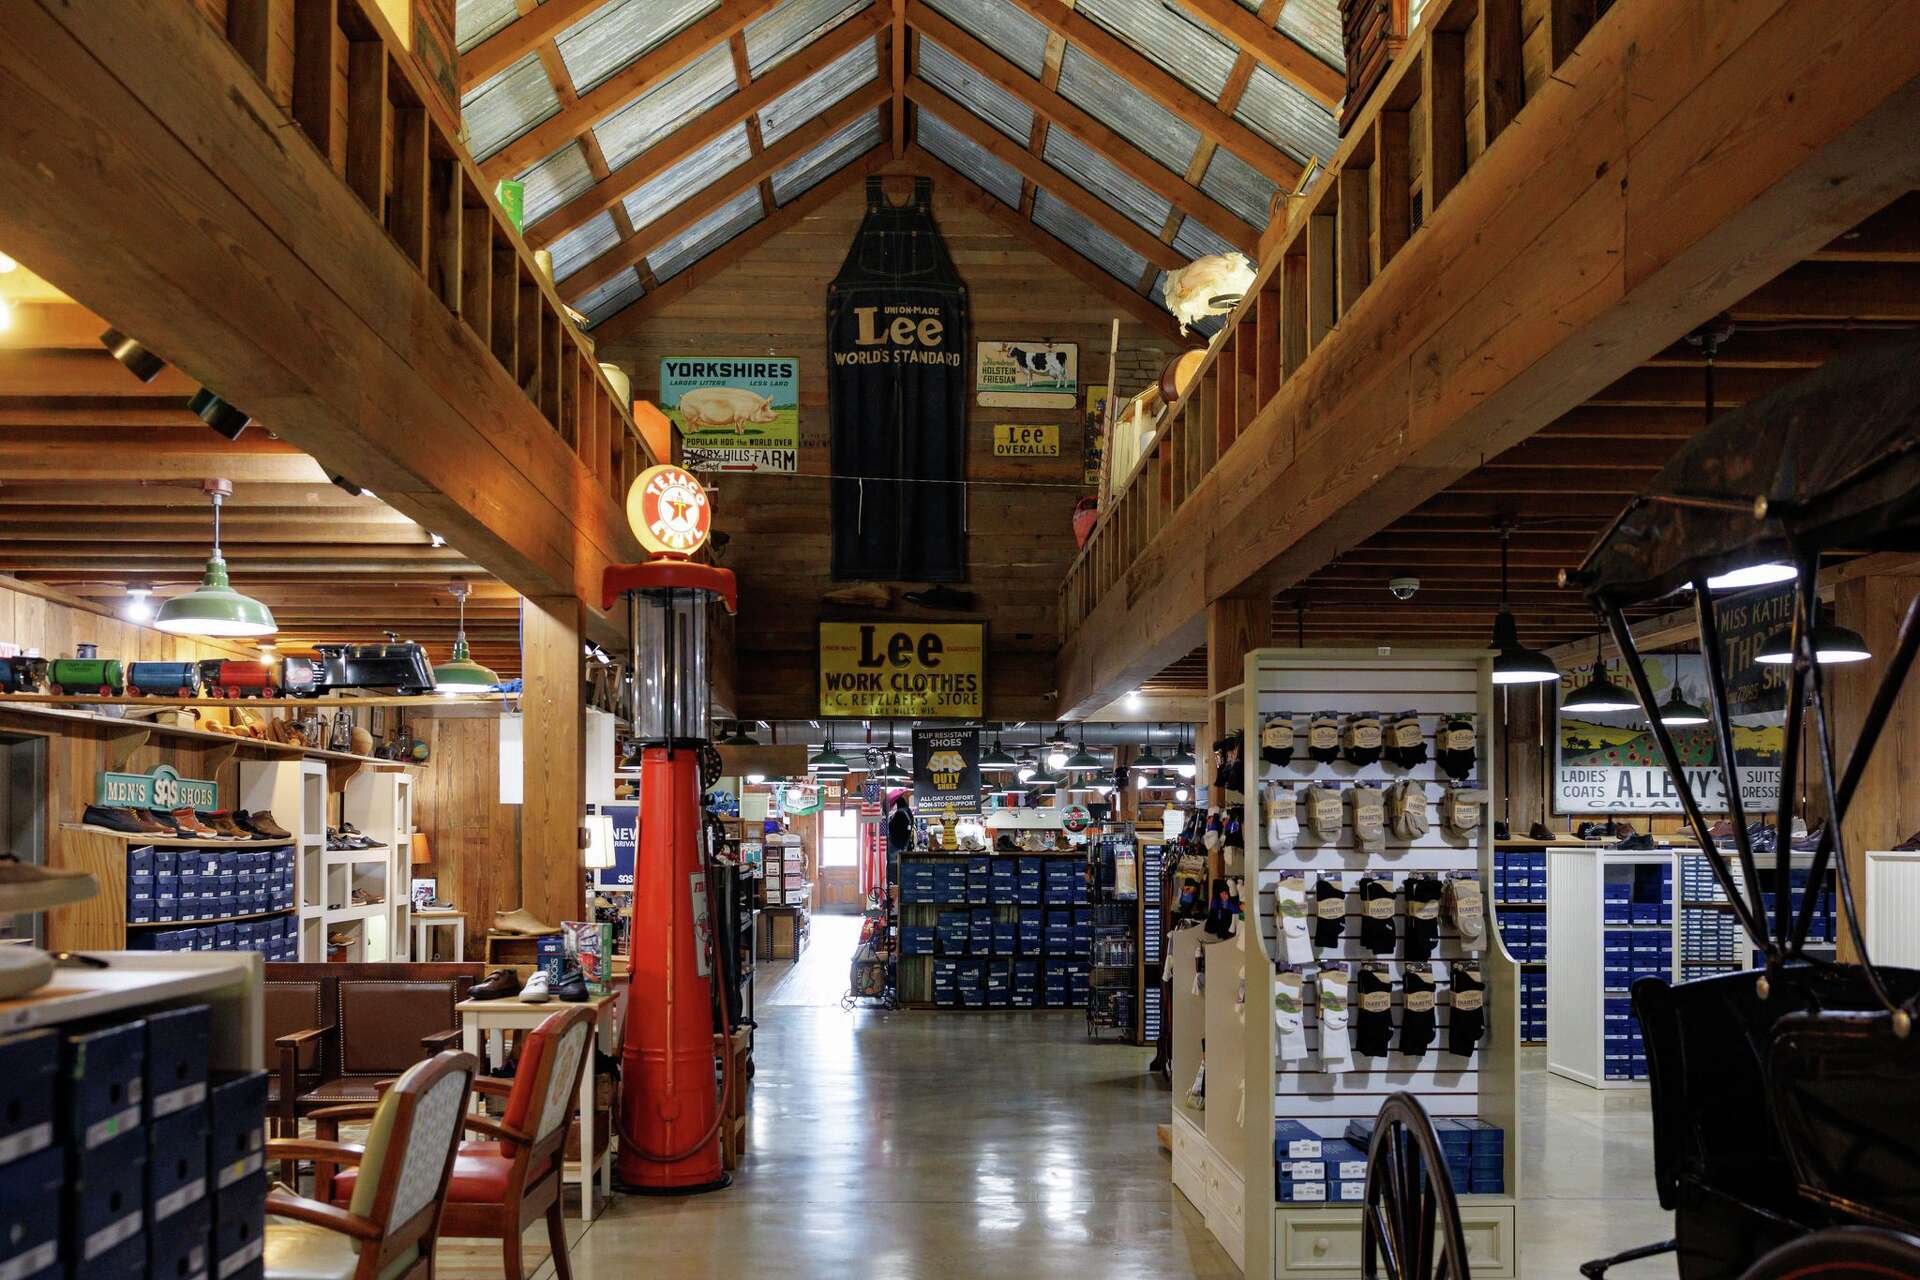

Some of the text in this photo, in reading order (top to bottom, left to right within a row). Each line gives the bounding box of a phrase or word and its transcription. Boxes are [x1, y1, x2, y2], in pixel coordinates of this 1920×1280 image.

[884, 306, 940, 315] UNION-MADE
[854, 306, 943, 346] Lee
[834, 349, 960, 366] WORLD'S STANDARD
[666, 362, 792, 378] YORKSHIRES
[983, 375, 1016, 384] FRIESIAN
[687, 438, 718, 446] POPULAR
[721, 438, 734, 446] HOG
[749, 438, 772, 446] WORLD
[775, 438, 792, 446] OVER
[1008, 427, 1043, 444] Lee
[997, 445, 1057, 455] OVERALLS
[646, 472, 704, 506] TEXACO
[1720, 605, 1747, 633] MISS
[858, 625, 943, 668] Lee
[826, 672, 977, 692] WORK CLOTHES
[852, 693, 928, 706] RETZLAFF'S
[938, 692, 979, 705] STORE
[930, 738, 962, 747] SHOES
[933, 772, 960, 784] DUTY
[1561, 769, 1609, 783] LADIES'
[1746, 770, 1782, 783] SUITS
[107, 778, 213, 807] MEN'S SAS SHOES
[1562, 785, 1781, 798] COATS DRESSE
[618, 874, 633, 883] SAS
[550, 958, 558, 985] SOCKS
